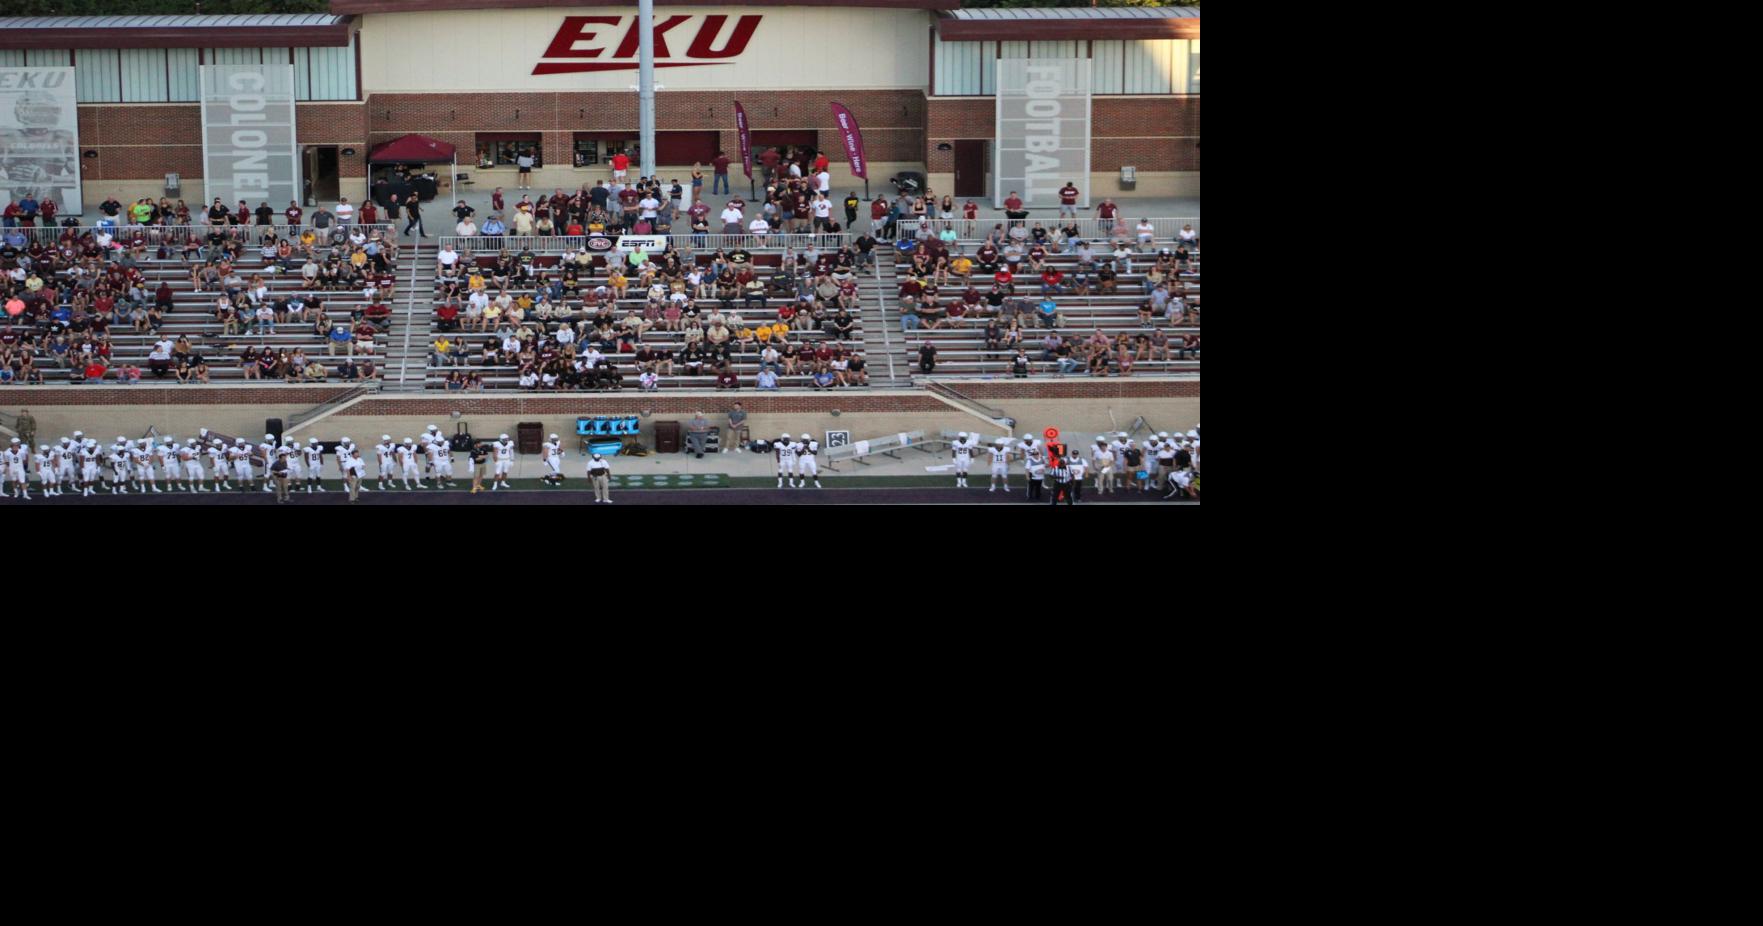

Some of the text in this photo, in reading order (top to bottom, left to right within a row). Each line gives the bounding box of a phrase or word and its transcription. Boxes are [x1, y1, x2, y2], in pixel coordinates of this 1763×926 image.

[542, 15, 763, 58] EKU
[0, 72, 66, 88] EKU
[838, 112, 861, 173] Beer Wine Here
[1025, 65, 1061, 202] FOOTBALL
[831, 432, 845, 448] 23
[1056, 444, 1065, 453] 1
